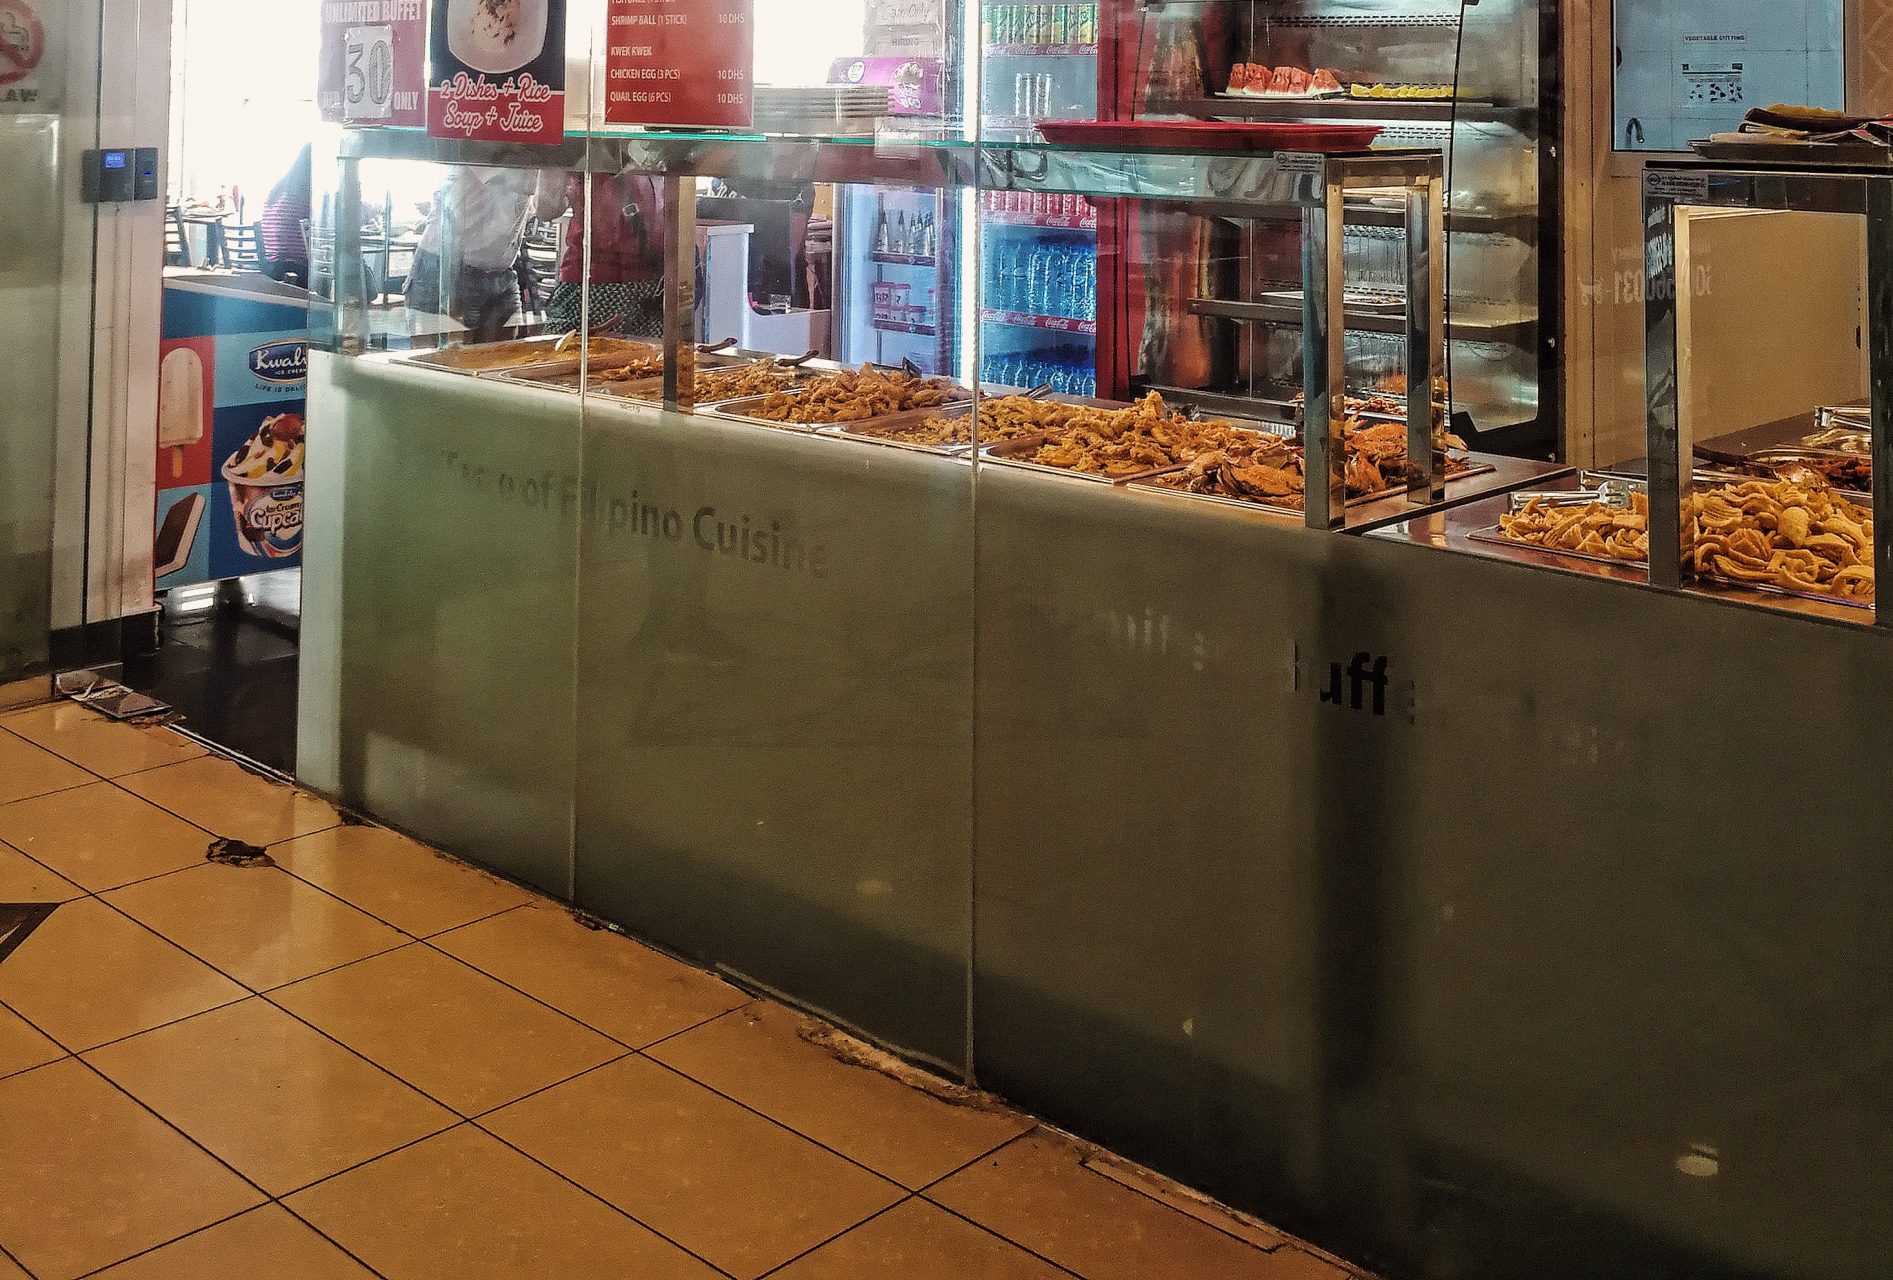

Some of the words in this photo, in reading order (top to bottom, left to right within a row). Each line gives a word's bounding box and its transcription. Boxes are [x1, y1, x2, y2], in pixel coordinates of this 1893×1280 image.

[325, 1, 380, 23] UNLIMITED
[382, 0, 422, 21] BUFFET
[347, 40, 392, 104] 30
[610, 69, 640, 79] CHICKEN
[642, 69, 656, 79] EGG
[717, 70, 727, 80] 10
[728, 70, 744, 80] DHS
[441, 80, 451, 97] 2
[453, 73, 497, 99] Dishes
[518, 73, 550, 101] Rice
[610, 91, 632, 103] QUAIL
[633, 92, 648, 102] EGG
[394, 91, 419, 110] ONLY
[444, 101, 482, 135] Soup
[501, 103, 543, 131] Juice
